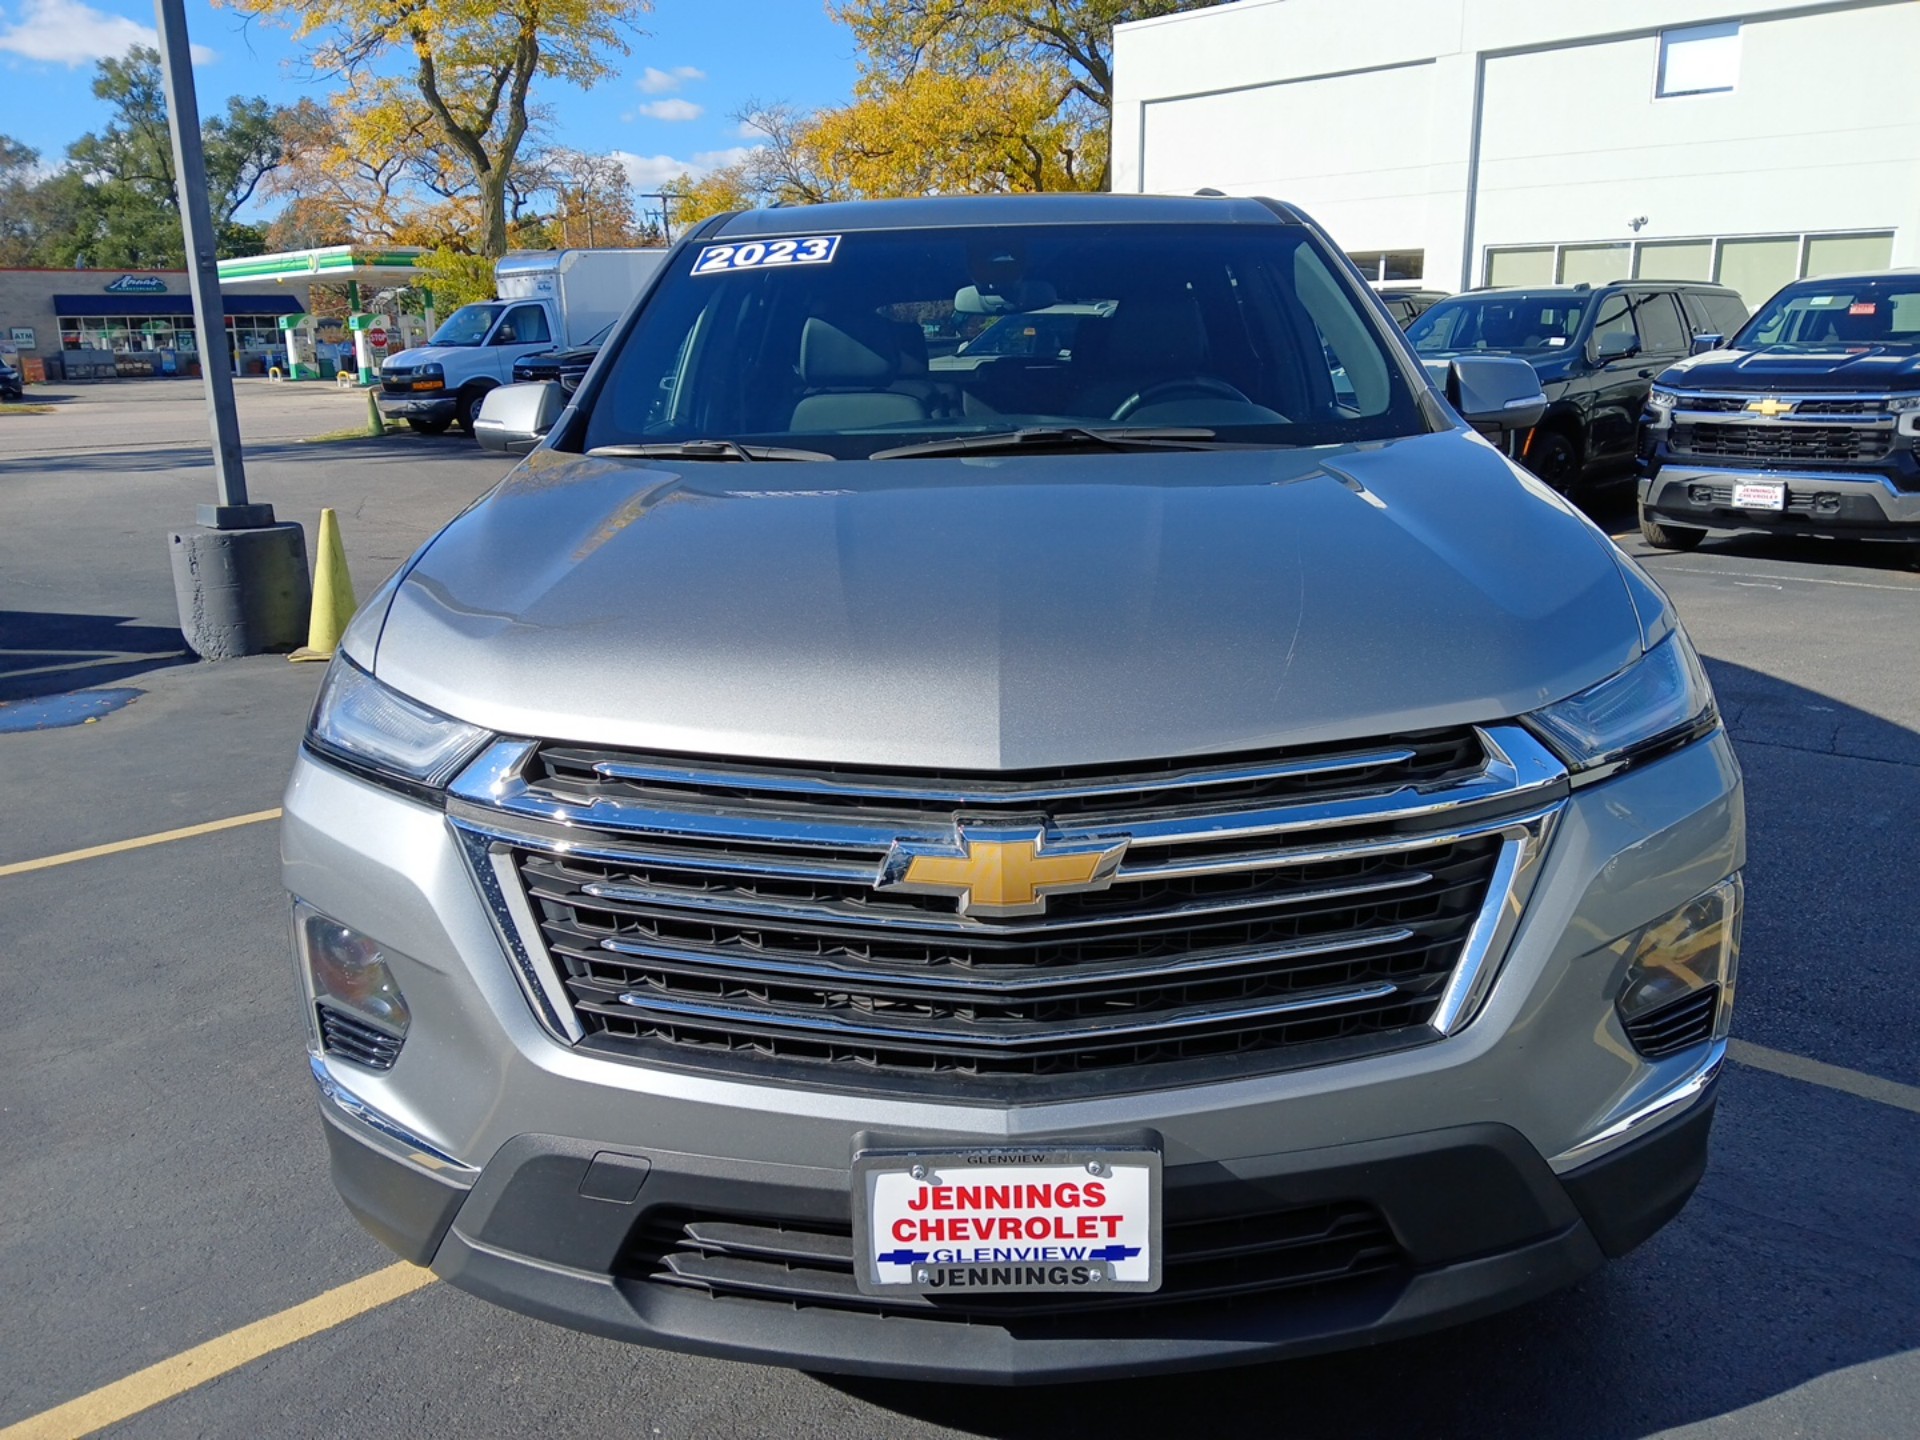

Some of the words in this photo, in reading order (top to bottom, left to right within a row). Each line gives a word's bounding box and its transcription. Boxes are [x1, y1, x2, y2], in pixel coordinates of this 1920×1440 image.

[699, 239, 830, 271] 2023
[110, 275, 163, 288] Anna's
[371, 333, 387, 341] STOP
[967, 1154, 1046, 1165] GLENVIEW
[908, 1182, 1106, 1211] JENNINGS
[891, 1215, 1124, 1242] CHEVROLET
[932, 1246, 1088, 1263] GLENVIEW
[929, 1266, 1090, 1288] JENNINGS
